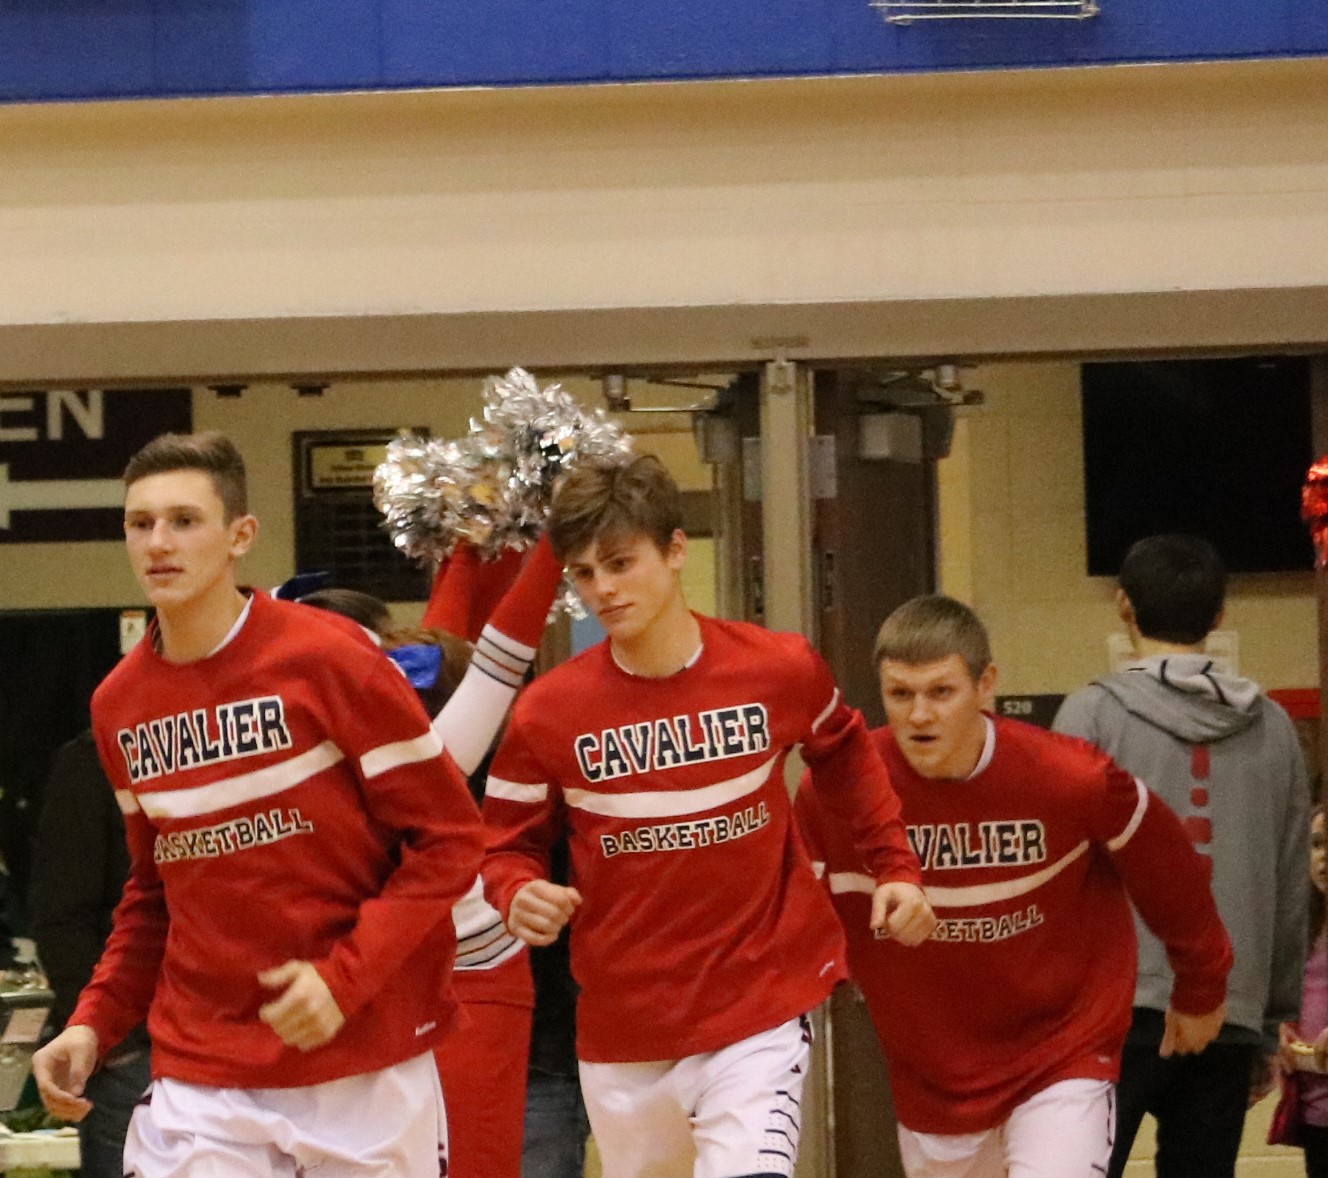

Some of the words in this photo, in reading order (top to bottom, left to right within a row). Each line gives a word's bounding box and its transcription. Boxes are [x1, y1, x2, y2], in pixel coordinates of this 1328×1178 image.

[117, 695, 293, 782] CAVALIER
[574, 702, 770, 782] CAVALIER
[601, 801, 771, 858] BASKETBALL
[906, 819, 1047, 871] VALIER
